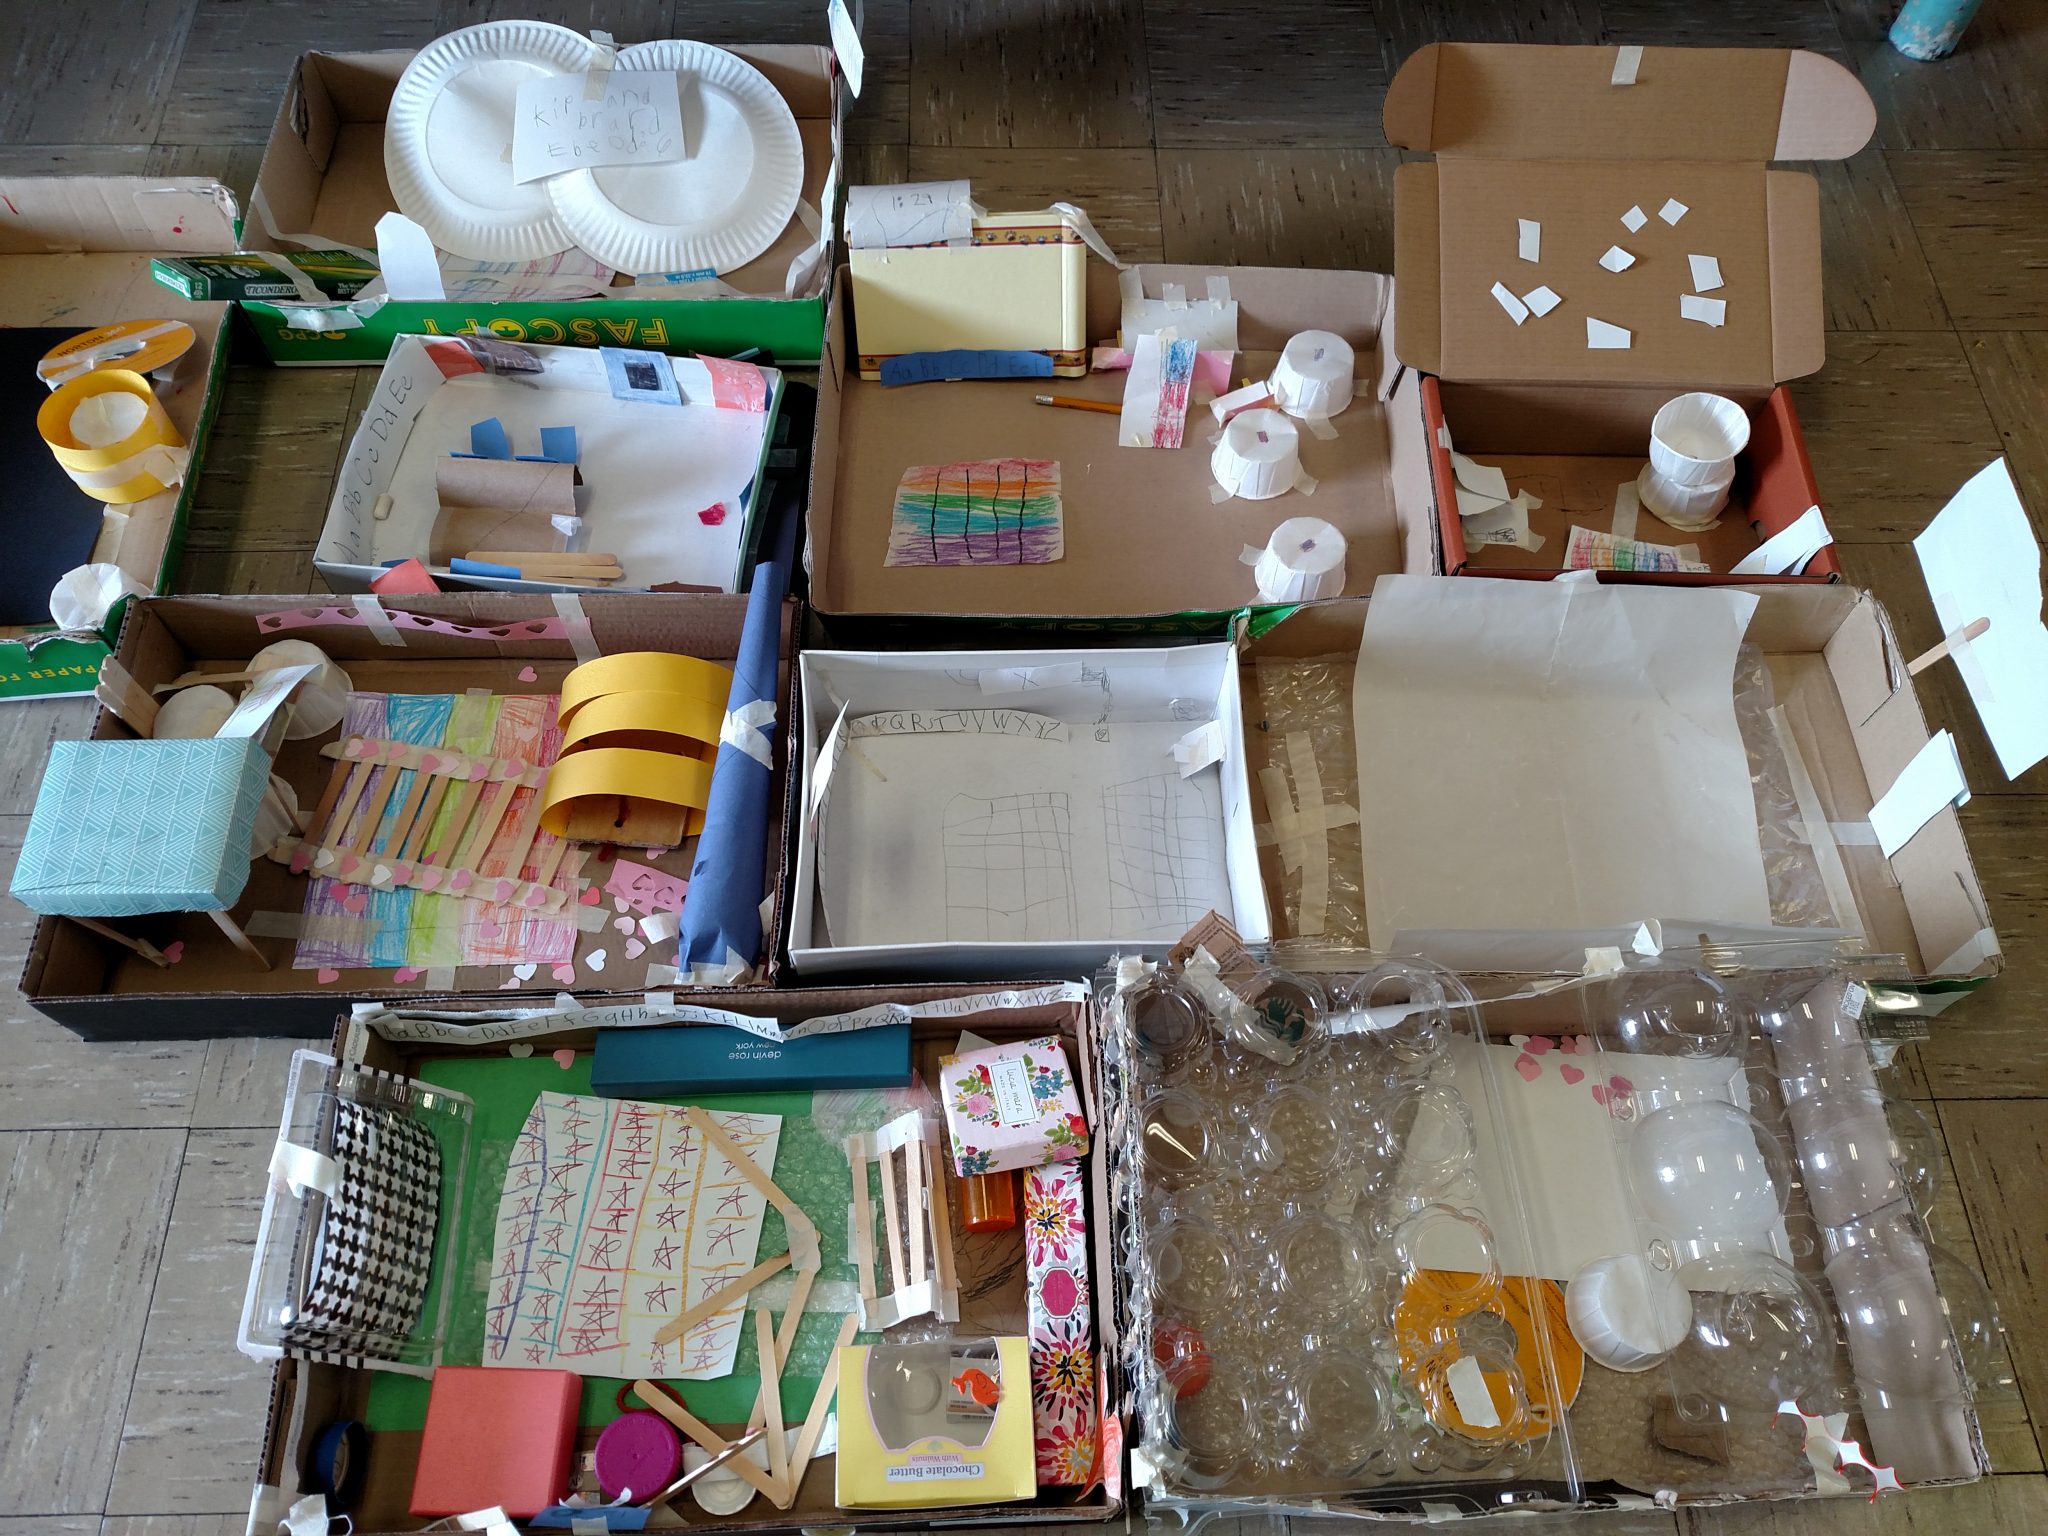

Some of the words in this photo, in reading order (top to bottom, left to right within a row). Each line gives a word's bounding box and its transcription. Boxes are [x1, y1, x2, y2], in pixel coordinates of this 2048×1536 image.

[27, 664, 97, 679] PAPER
[735, 1041, 755, 1051] york
[728, 1051, 750, 1060] rose
[752, 1050, 782, 1061] devin
[911, 1455, 941, 1463] Walnuts
[942, 1454, 959, 1463] With
[888, 1467, 924, 1478] Butter
[926, 1464, 980, 1476] Chocolate
